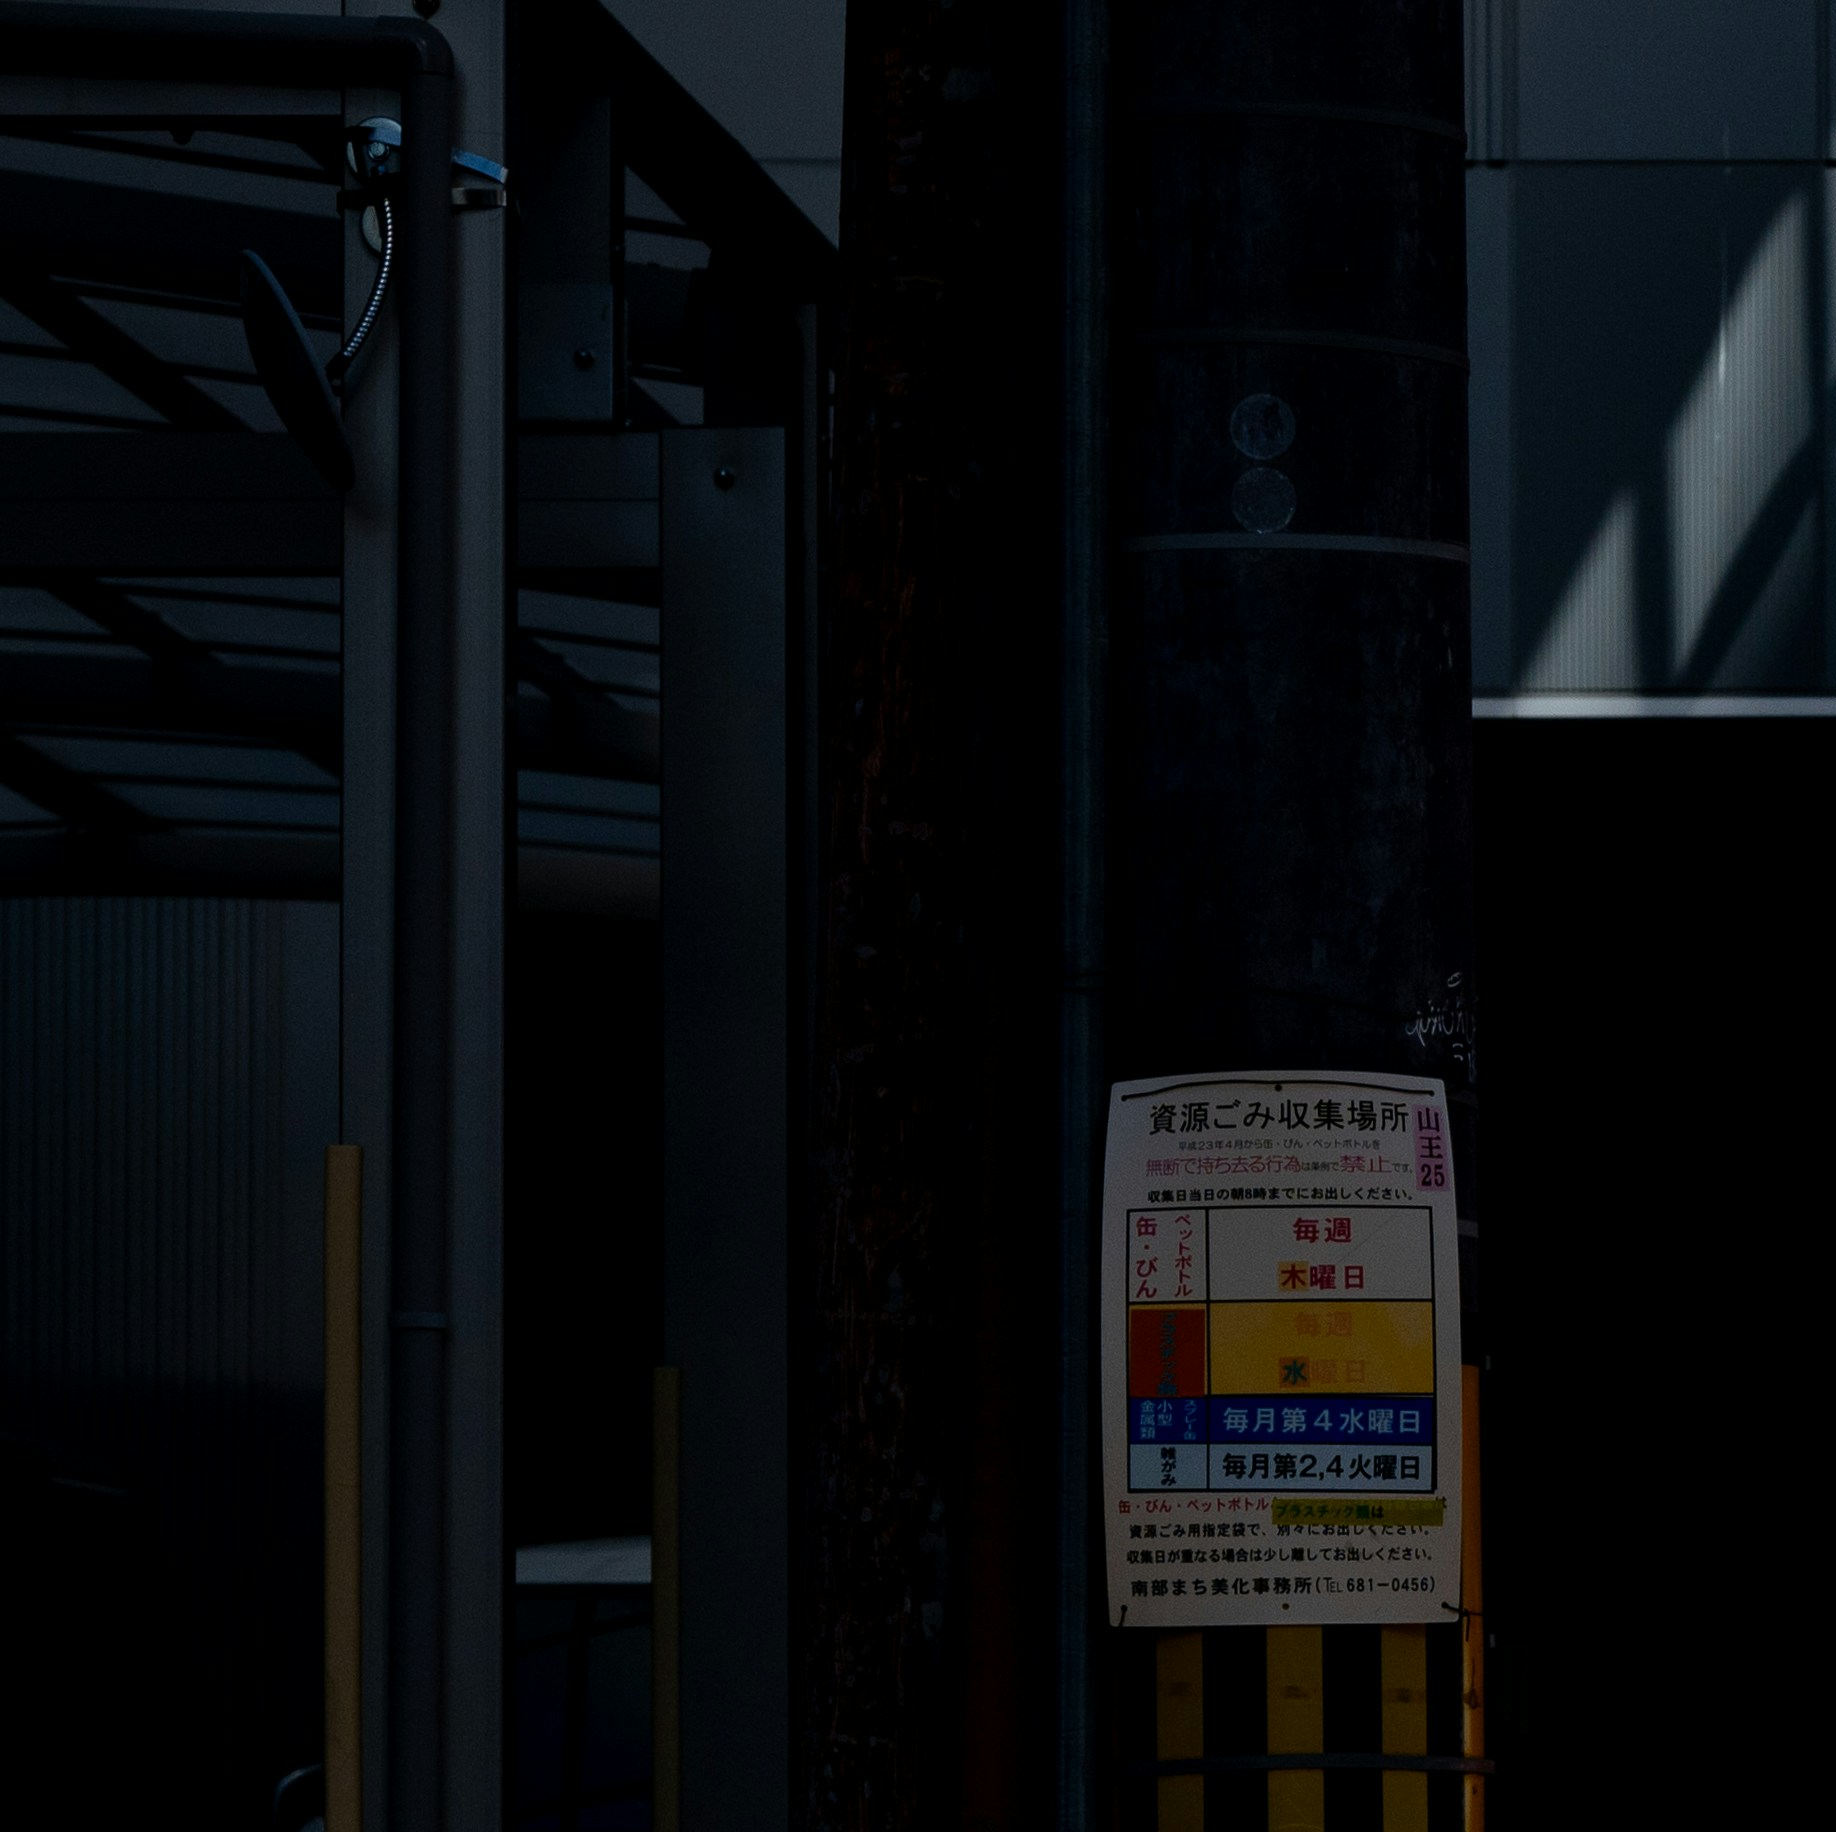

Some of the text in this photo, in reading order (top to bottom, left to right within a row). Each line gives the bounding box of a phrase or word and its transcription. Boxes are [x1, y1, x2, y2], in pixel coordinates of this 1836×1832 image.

[1150, 1100, 1409, 1134] 資源ごみ収集場所
[1178, 1138, 1380, 1150] 平成23年4月から缶・びん・ペットボトルを
[1418, 1108, 1445, 1187] 山王25
[1146, 1154, 1413, 1178] 無断で持ち去る行為は条例で禁止です。
[1148, 1186, 1413, 1202] 収集日当日の朝8時までにお出しください。
[1293, 1218, 1352, 1243] 毎週
[1135, 1217, 1157, 1298] 缶・びん
[1175, 1214, 1193, 1297] ペットボトル
[1280, 1264, 1365, 1290] 木曜日
[1281, 1359, 1366, 1386] 水曜日
[1222, 1406, 1421, 1435] 毎月第4水曜日
[1161, 1447, 1177, 1486] 雑がみ
[1222, 1453, 1420, 1482] 毎月第2,4火曜日
[1127, 1547, 1433, 1564] 収集日が重なる場合は少し離してお出しください。
